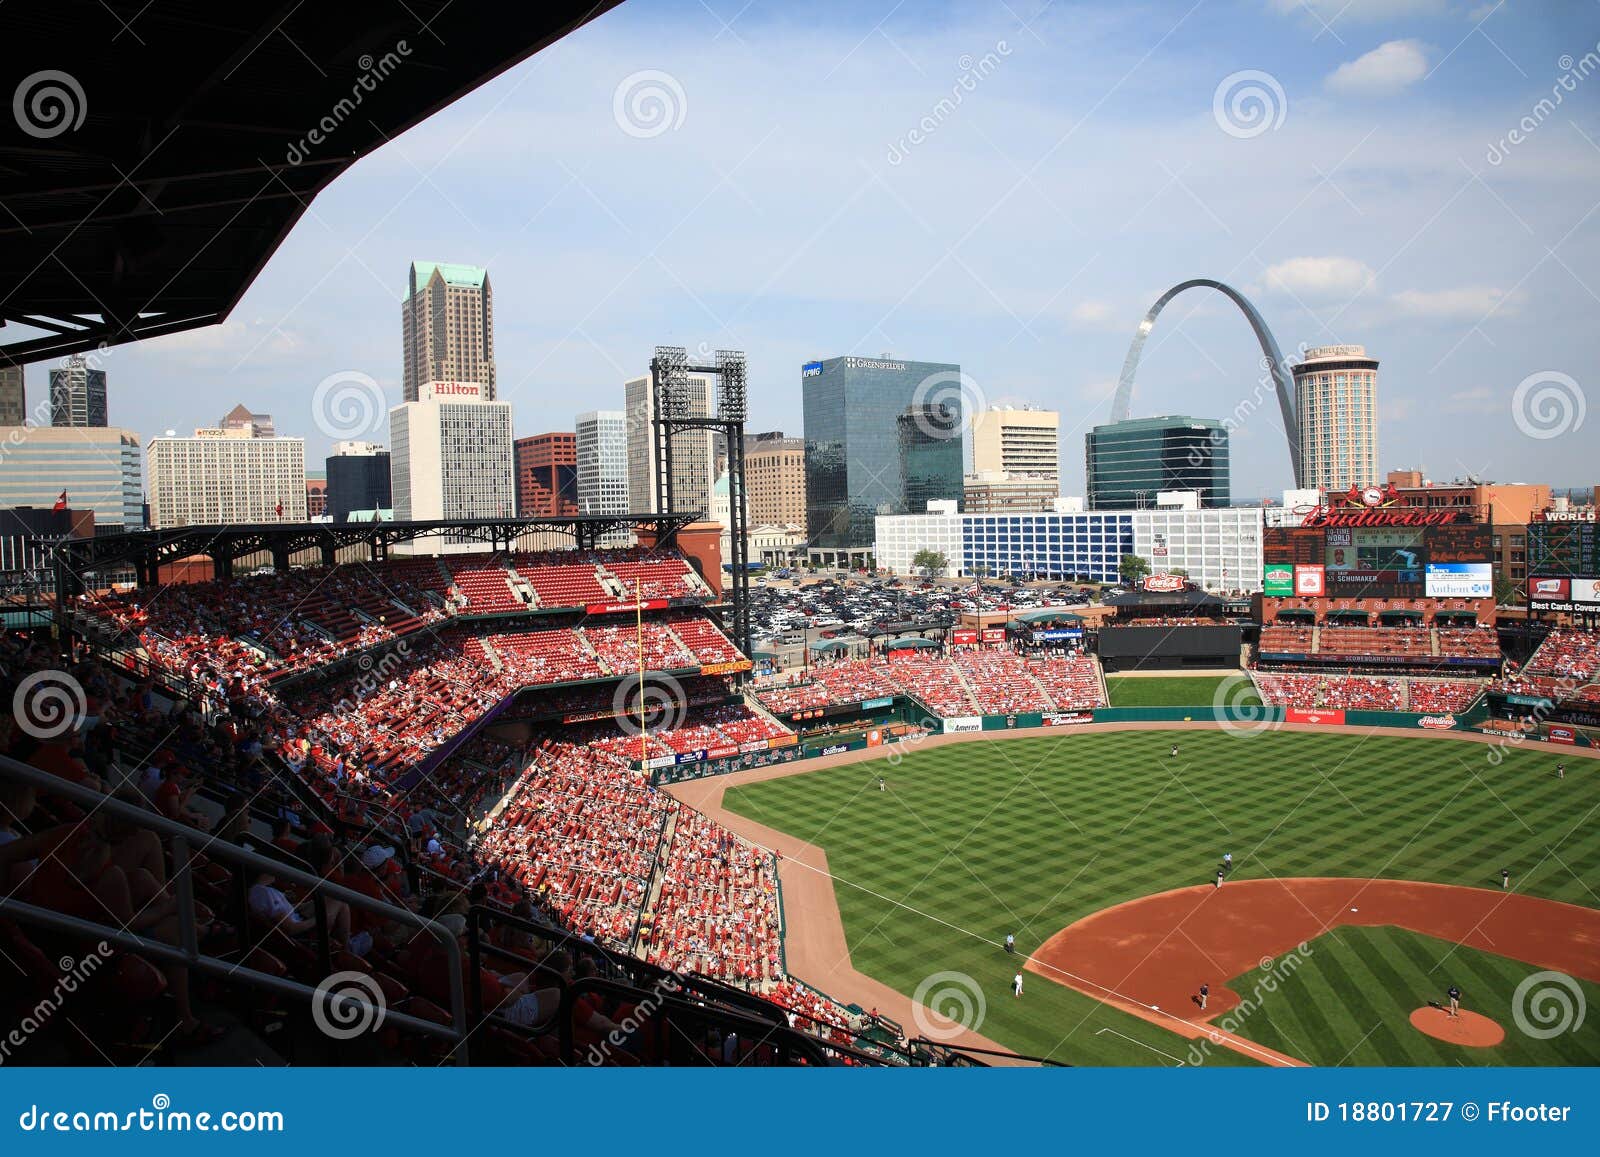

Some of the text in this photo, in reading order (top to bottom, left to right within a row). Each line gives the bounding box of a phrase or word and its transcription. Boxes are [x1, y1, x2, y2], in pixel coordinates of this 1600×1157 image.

[803, 367, 821, 378] KPMG
[435, 382, 479, 396] Hilton
[1298, 505, 1458, 528] Budweiser
[1545, 512, 1596, 521] WORLD
[1327, 534, 1350, 542] WORLD
[1429, 583, 1469, 593] Anthem
[1531, 601, 1550, 610] Best
[1550, 602, 1573, 611] Cards
[954, 723, 980, 732] Ameren
[1482, 728, 1501, 736] BUSCH
